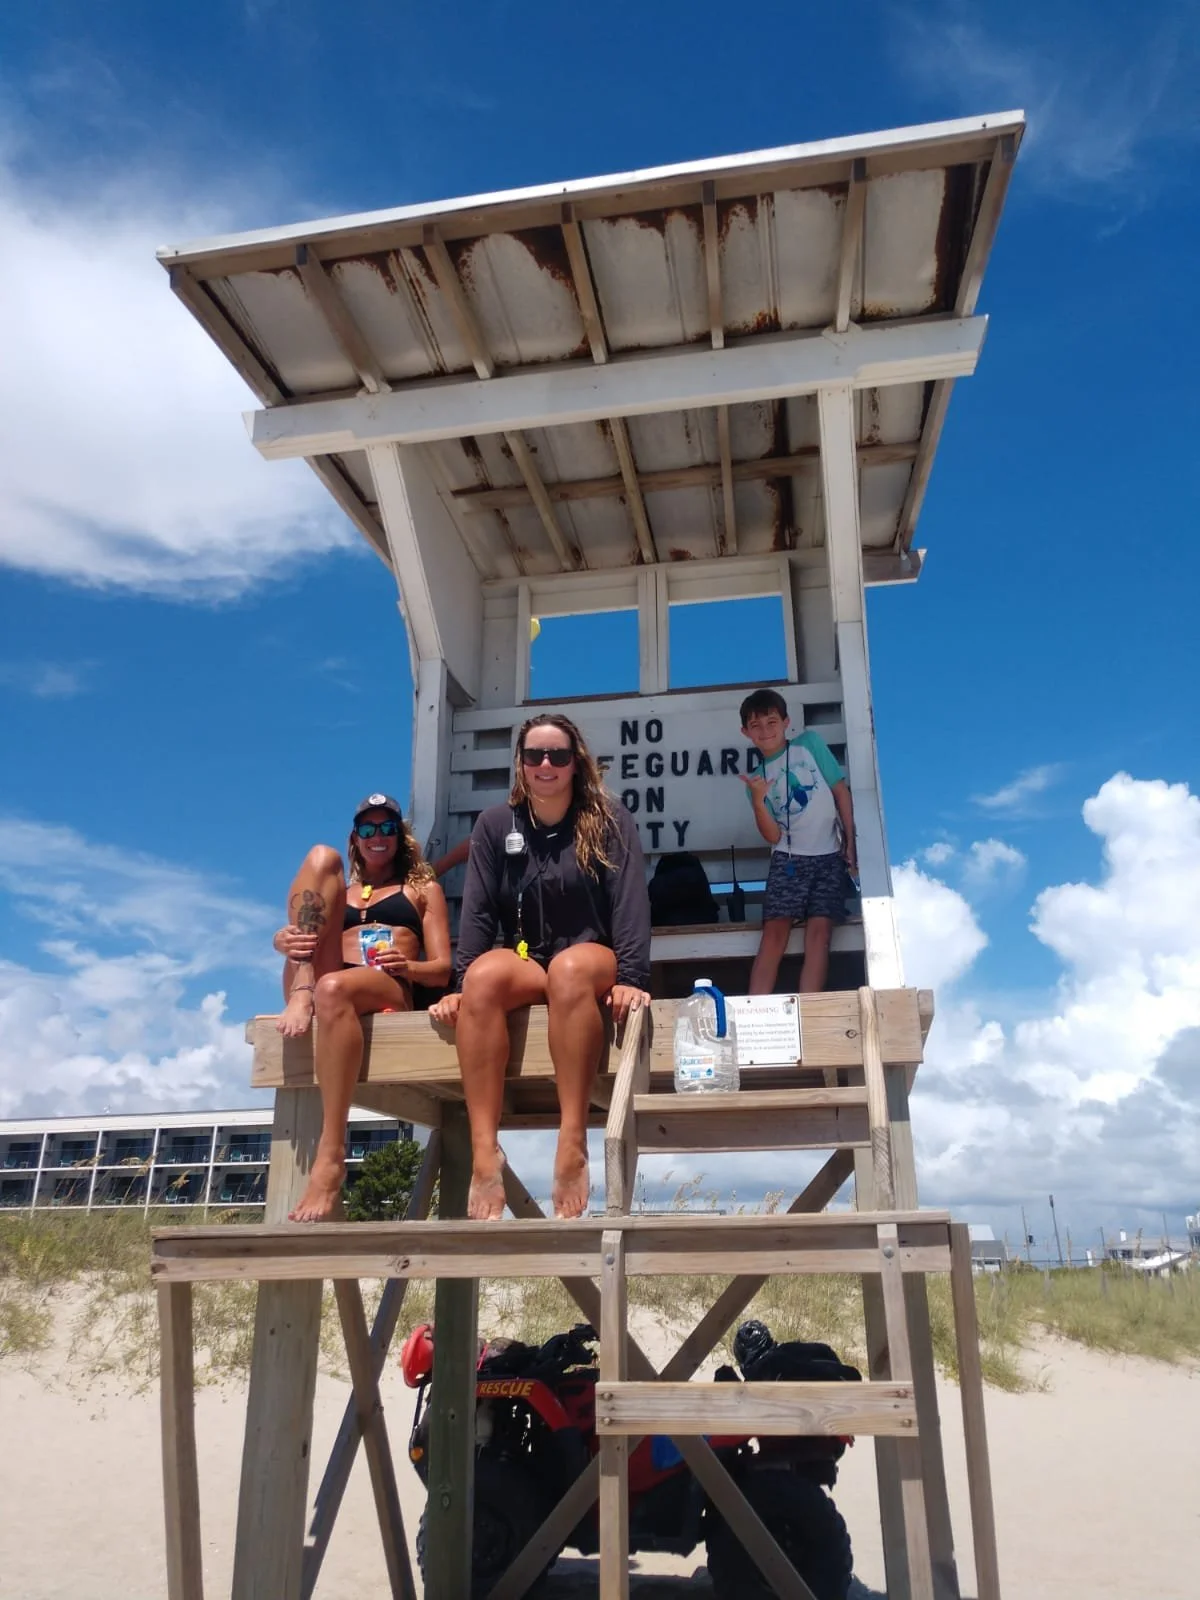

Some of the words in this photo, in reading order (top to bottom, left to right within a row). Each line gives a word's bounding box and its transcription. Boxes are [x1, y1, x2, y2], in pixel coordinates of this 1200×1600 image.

[620, 719, 663, 746] NO
[597, 747, 764, 780] FEGUARD
[621, 786, 665, 814] ON
[636, 820, 690, 849] TY
[735, 1006, 779, 1016] RESPASSING
[479, 1381, 534, 1396] RESCUE
